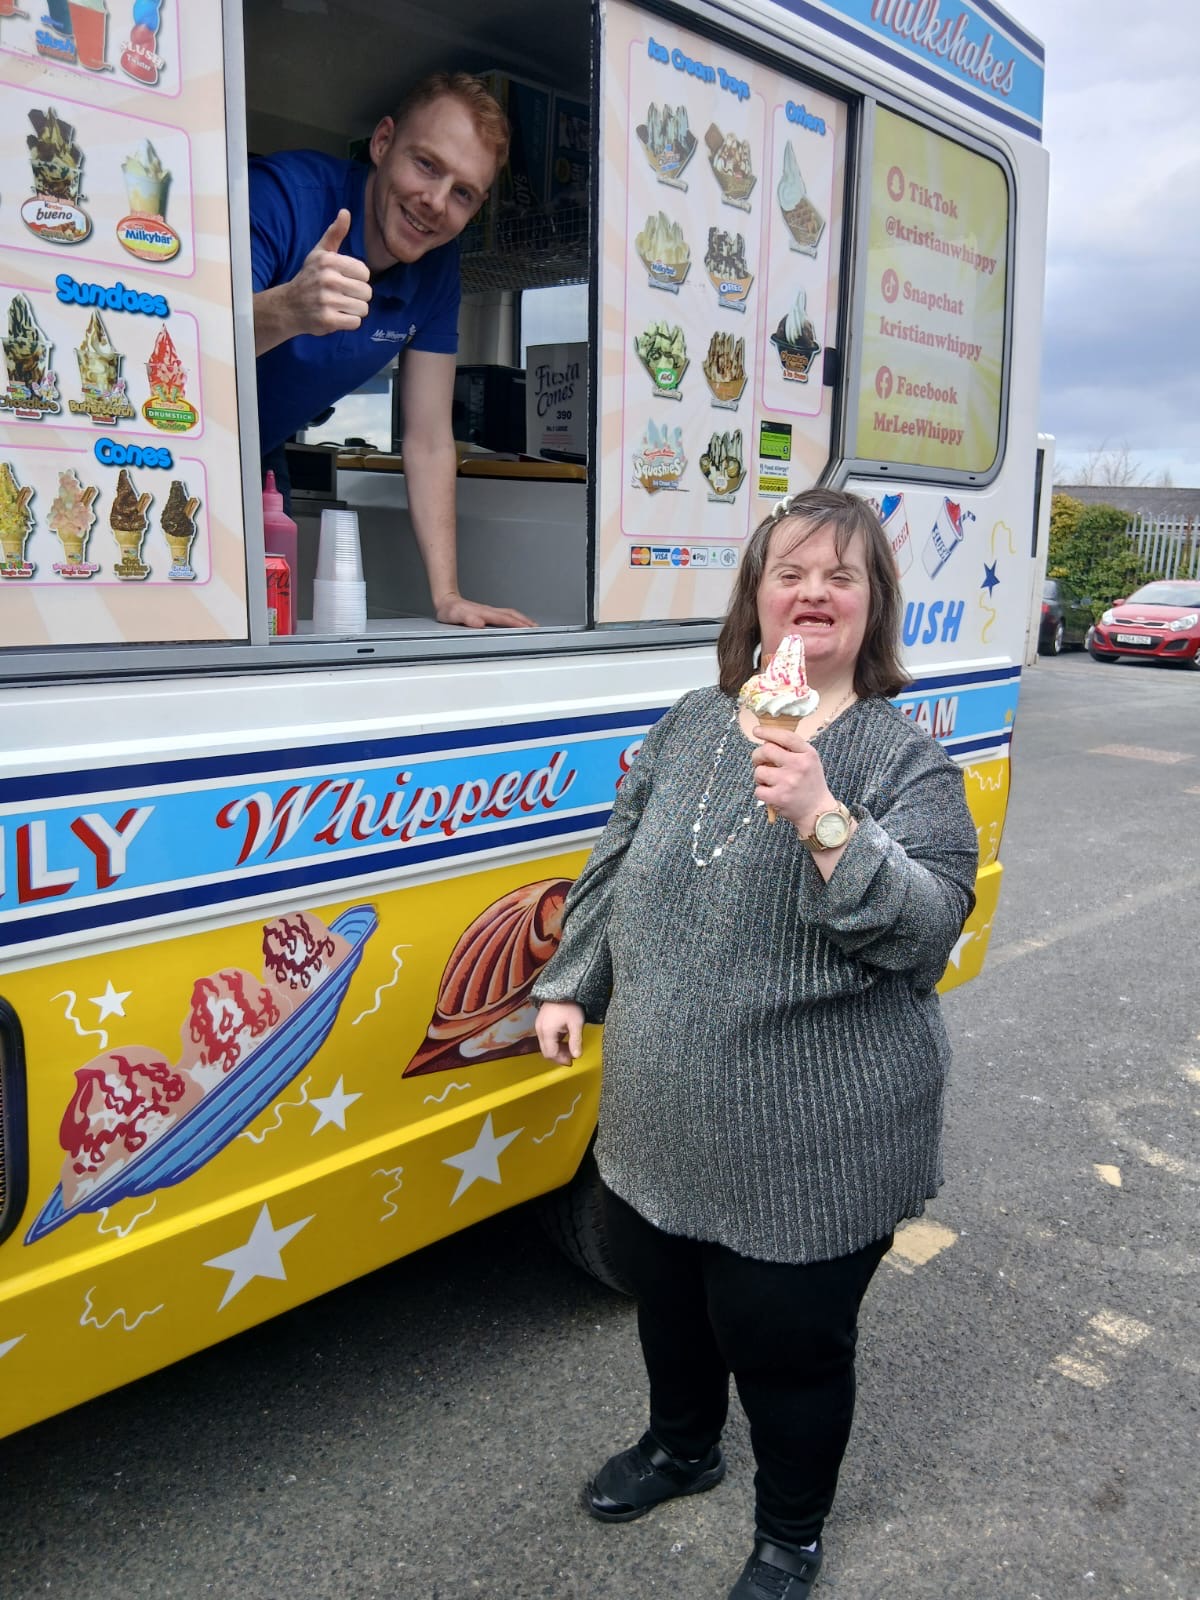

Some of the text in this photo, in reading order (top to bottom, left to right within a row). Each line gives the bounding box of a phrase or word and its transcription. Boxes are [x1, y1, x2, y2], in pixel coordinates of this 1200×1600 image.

[671, 48, 716, 83] Cream
[785, 100, 826, 136] Others
[36, 208, 73, 221] bueno
[909, 181, 958, 220] TikTok
[125, 229, 172, 245] Milkybar
[885, 215, 997, 275] @kristianwhippy
[55, 273, 170, 317] Sundaes
[902, 281, 965, 316] Snapchat
[879, 316, 983, 362] kristianwhippy
[535, 362, 580, 393] Fiesta
[896, 375, 958, 404] Facebook
[148, 410, 192, 420] DRUMSTICK
[535, 382, 575, 417] Cones
[556, 410, 572, 420] 390
[872, 412, 965, 446] MrLeeWhippy
[94, 437, 172, 468] Cones
[634, 458, 681, 479] Squashies
[654, 552, 668, 560] VISA
[215, 751, 577, 867] Whipped
